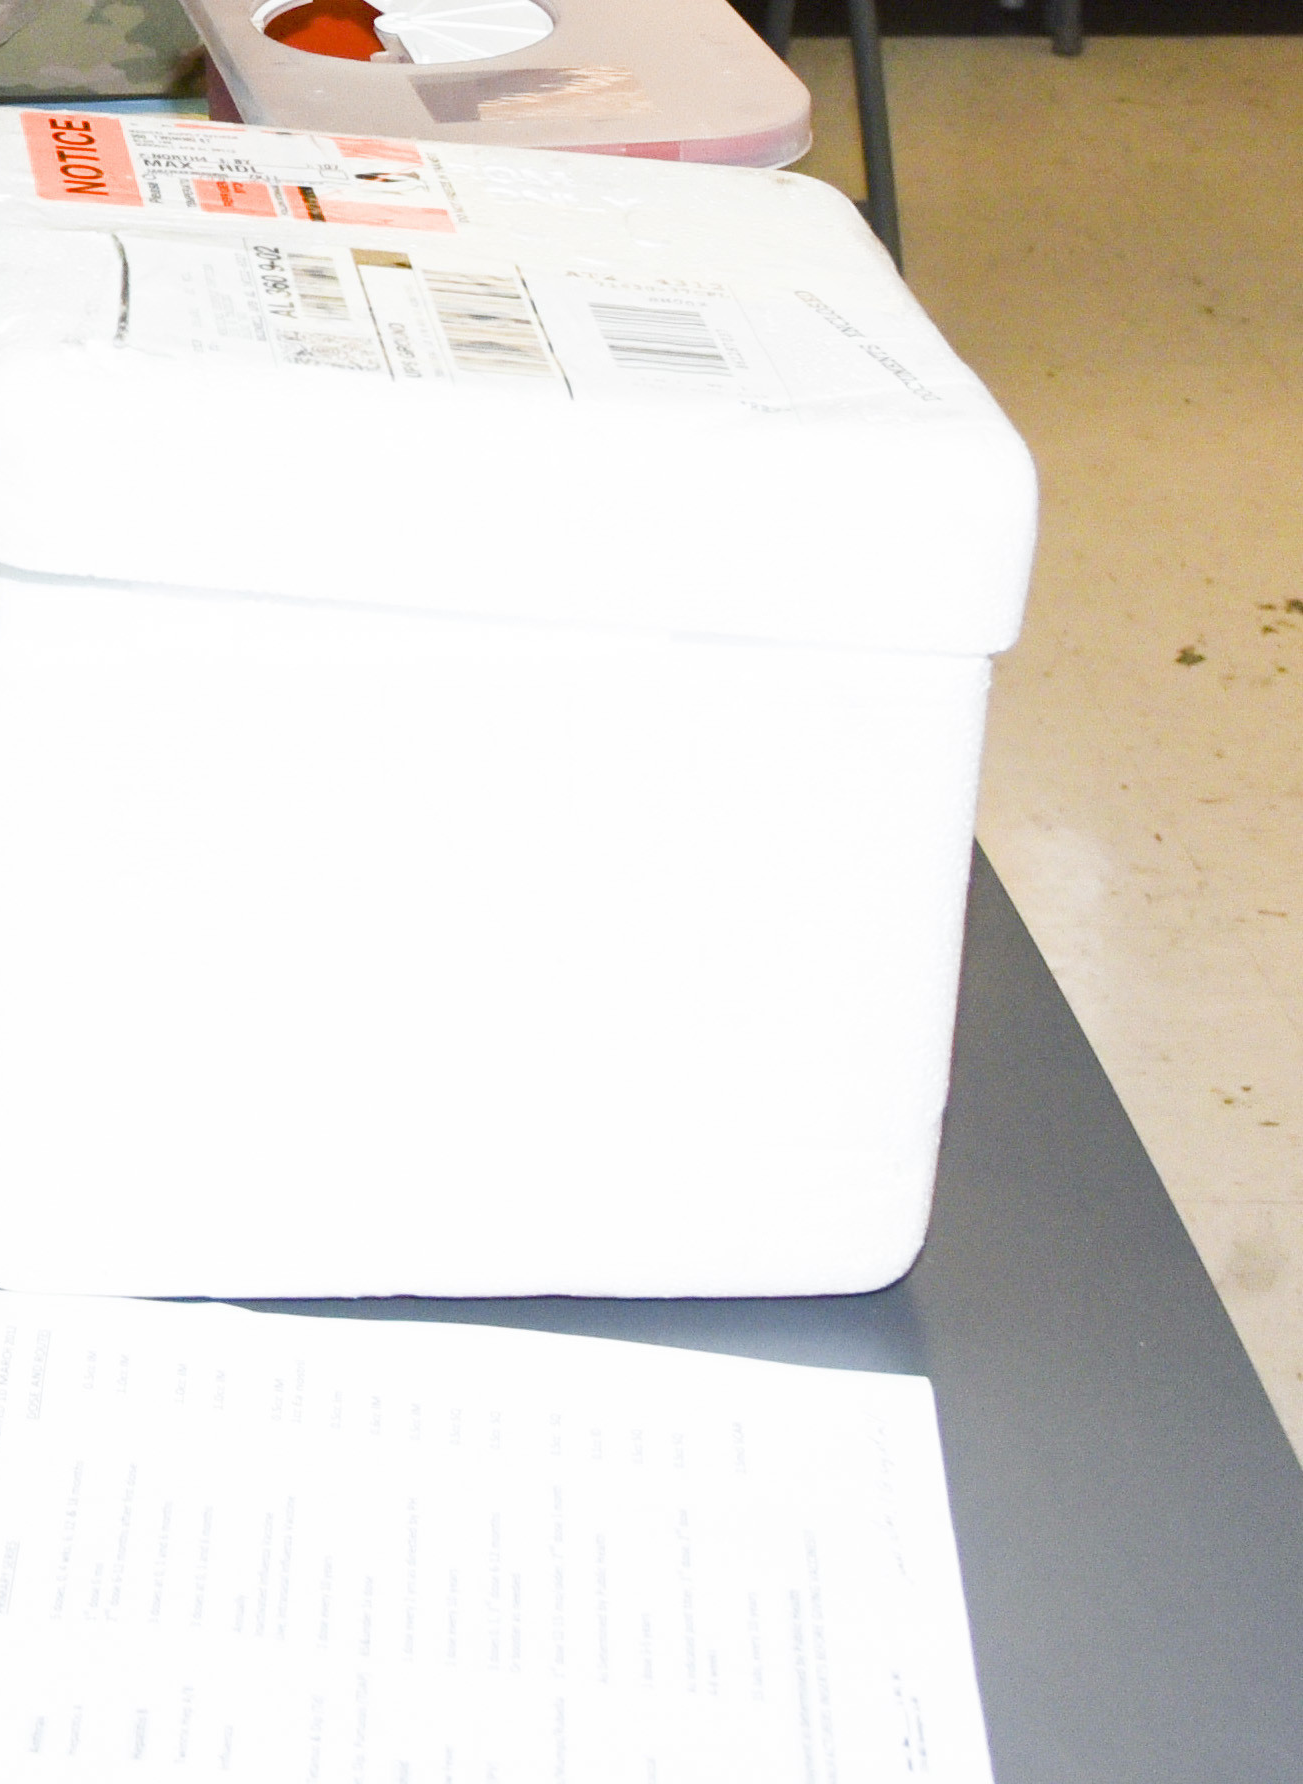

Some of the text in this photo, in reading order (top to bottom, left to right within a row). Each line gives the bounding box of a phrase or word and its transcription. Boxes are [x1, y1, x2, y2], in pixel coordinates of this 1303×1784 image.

[47, 116, 111, 198] NOTICE
[259, 274, 290, 297] 360
[268, 301, 298, 320] AL
